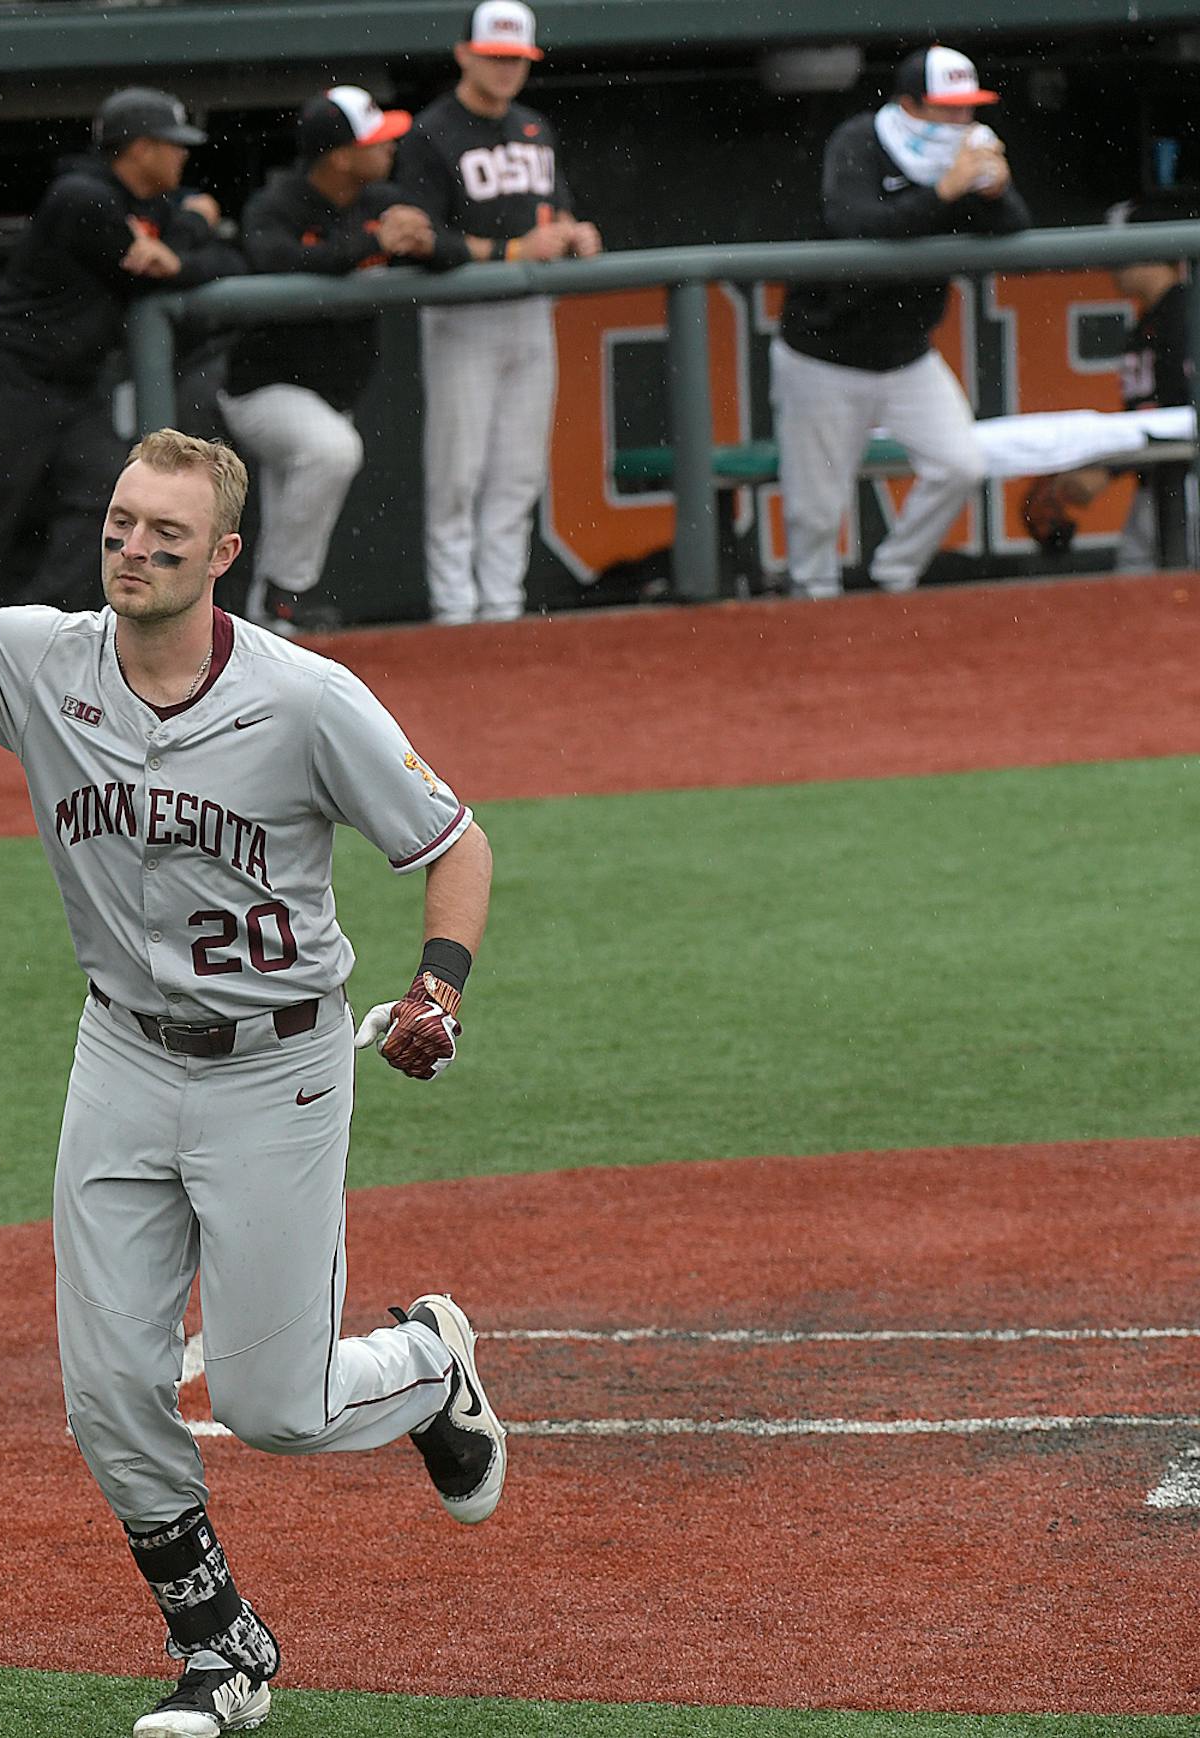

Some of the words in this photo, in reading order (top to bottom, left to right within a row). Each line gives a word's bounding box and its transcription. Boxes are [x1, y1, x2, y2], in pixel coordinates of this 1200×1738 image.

[460, 141, 555, 201] OSU
[55, 781, 274, 892] MINNESOTA
[187, 900, 298, 977] 20
